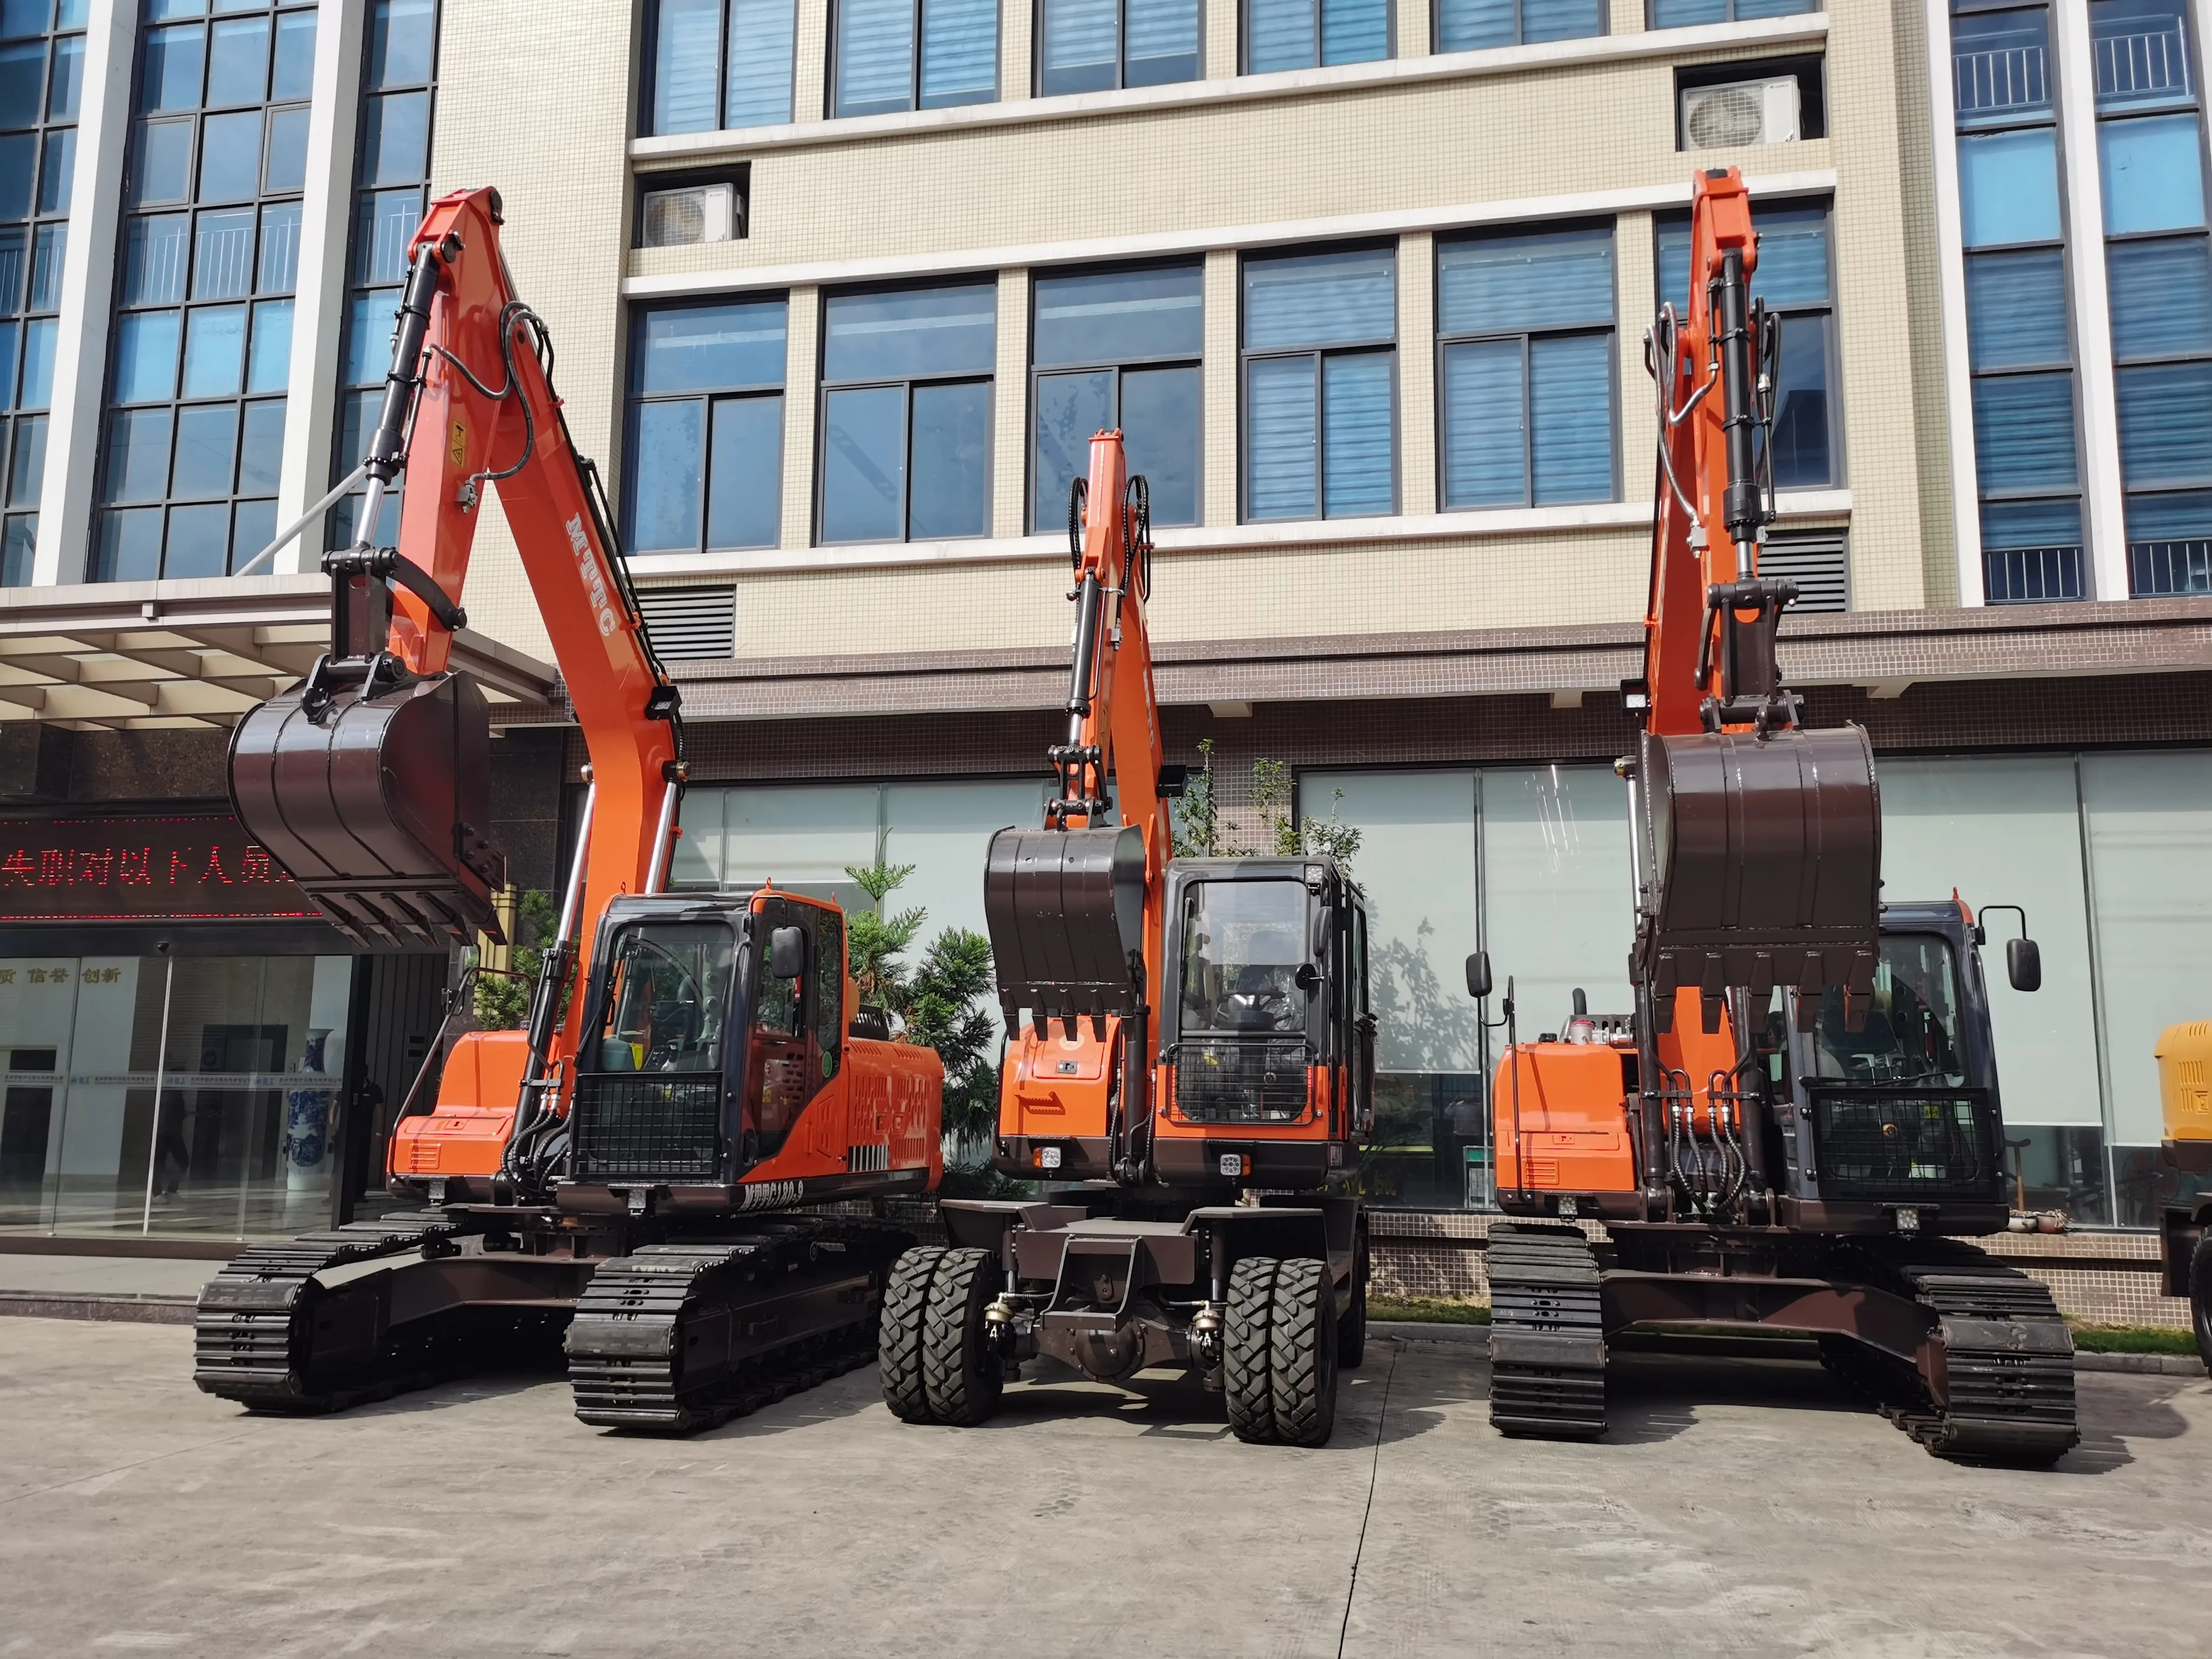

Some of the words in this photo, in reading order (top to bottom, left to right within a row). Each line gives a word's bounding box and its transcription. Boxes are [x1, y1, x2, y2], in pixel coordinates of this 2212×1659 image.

[566, 512, 616, 637] MTTC
[27, 968, 70, 984] 信誉
[81, 967, 121, 984] 创新
